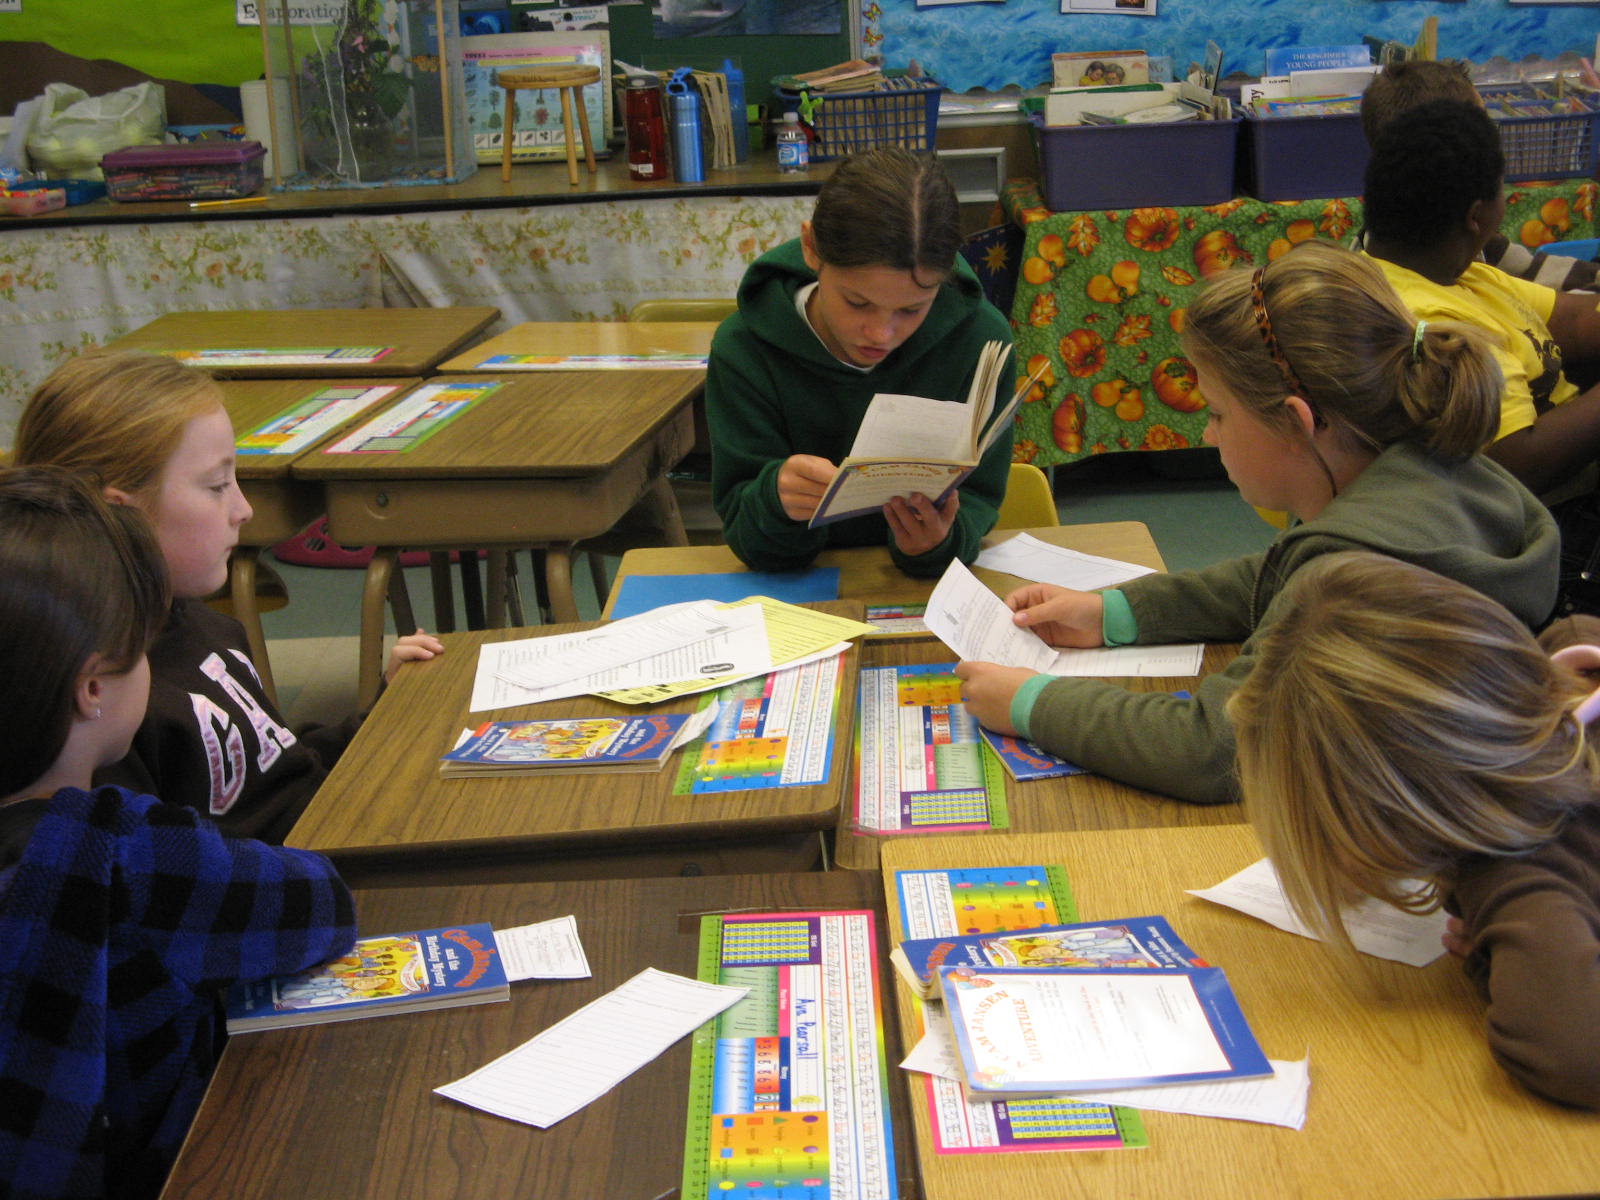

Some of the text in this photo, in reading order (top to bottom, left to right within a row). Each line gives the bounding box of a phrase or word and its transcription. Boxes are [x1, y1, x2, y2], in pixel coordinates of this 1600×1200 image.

[1286, 61, 1316, 69] YOUNG
[426, 935, 446, 987] Birthday Mystery
[445, 948, 460, 971] and the
[795, 998, 818, 1059] Ava Pearsall
[971, 990, 1010, 1033] JANSEN
[1012, 998, 1044, 1063] ADVENTURE
